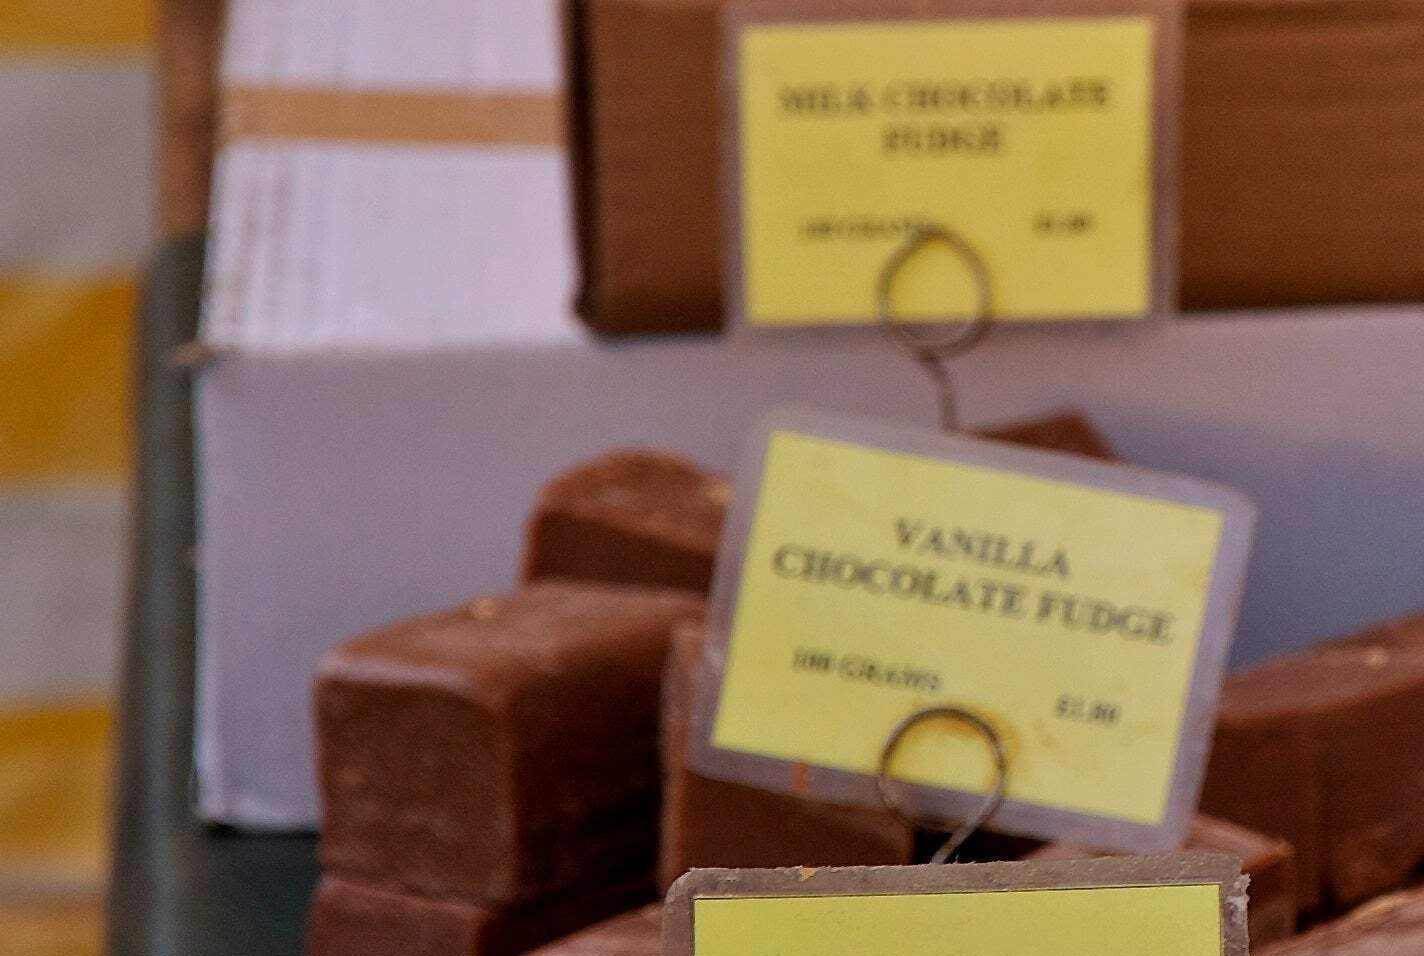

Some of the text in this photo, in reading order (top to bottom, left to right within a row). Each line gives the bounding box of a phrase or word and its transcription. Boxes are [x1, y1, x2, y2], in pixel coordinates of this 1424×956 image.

[894, 517, 1071, 580] VANILLA
[772, 543, 1176, 646] CHOCOLATE FUDGE
